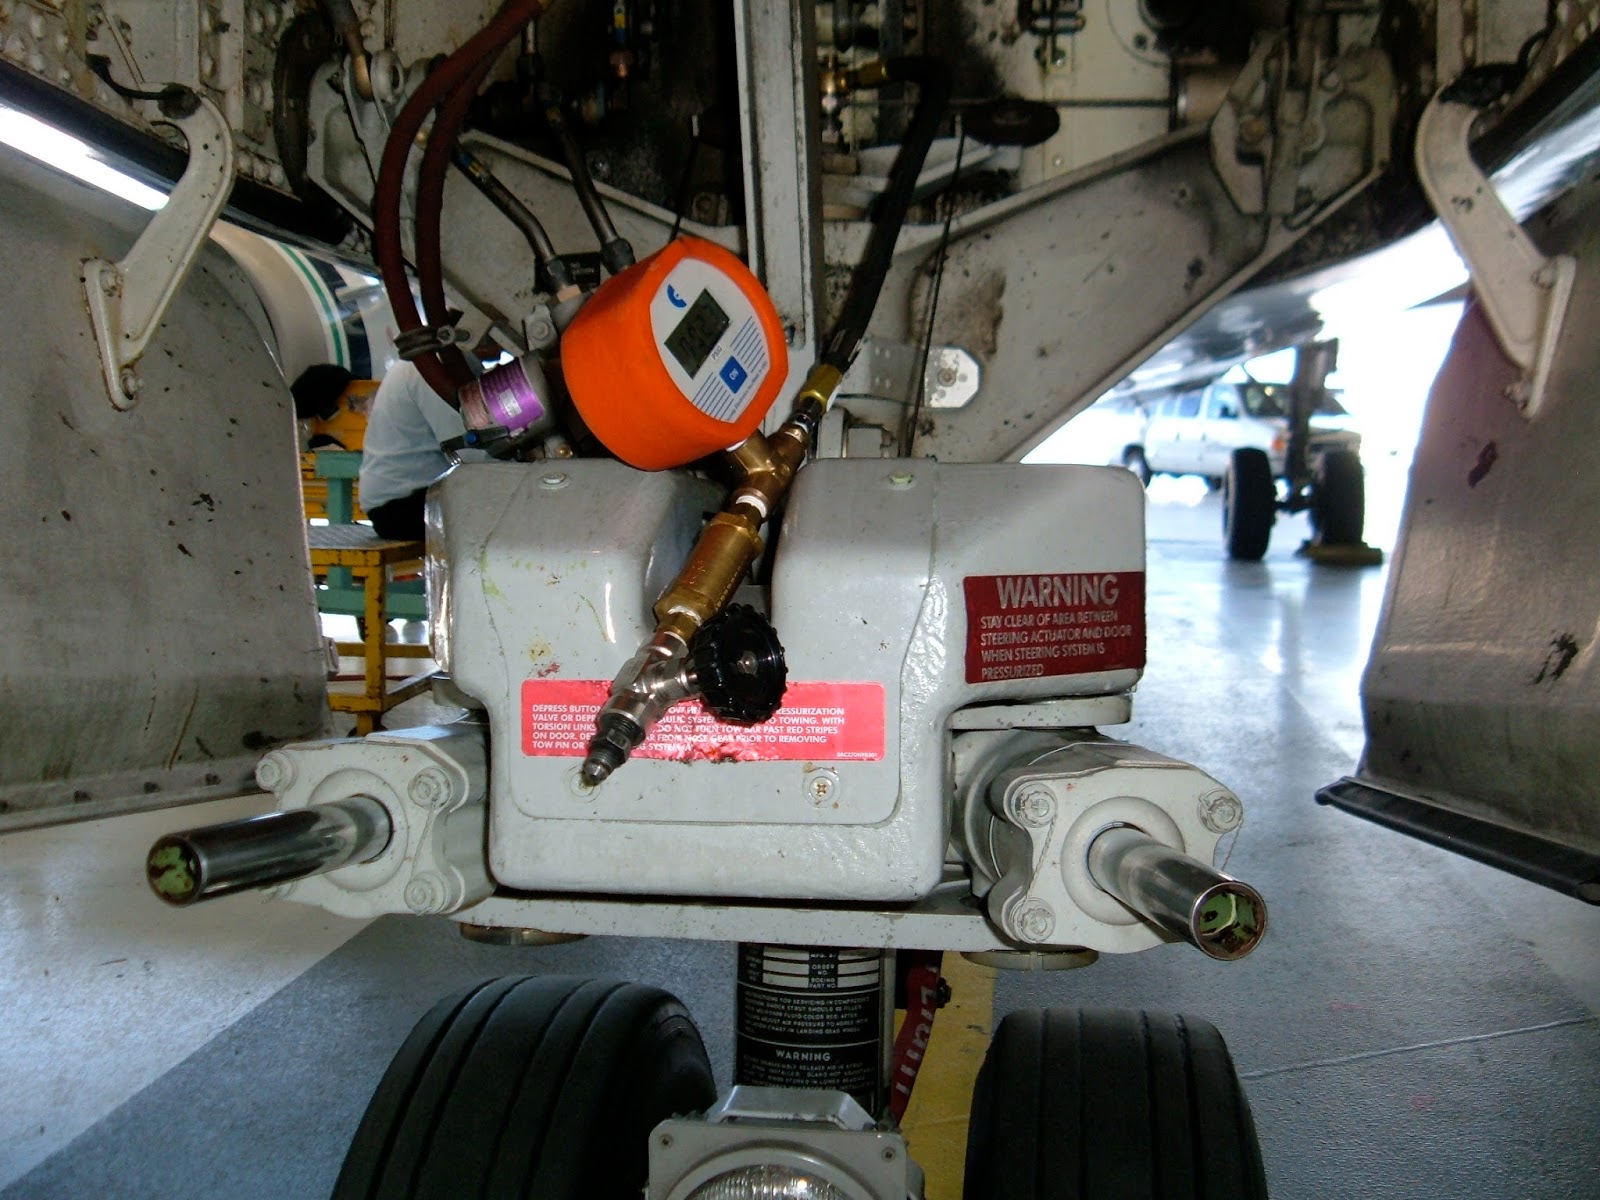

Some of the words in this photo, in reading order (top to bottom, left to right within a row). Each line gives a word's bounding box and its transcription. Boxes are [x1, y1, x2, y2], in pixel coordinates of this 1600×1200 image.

[729, 368, 739, 380] ON
[996, 574, 1119, 609] WARNING
[980, 615, 1002, 629] STAY
[1004, 614, 1035, 628] CLEAR
[1036, 613, 1050, 627] OF
[1052, 612, 1076, 626] AREA
[1077, 610, 1118, 624] BETWEEN
[980, 631, 1028, 646] STEERING
[1030, 628, 1081, 644] ACTUATOR
[1082, 626, 1102, 639] AND
[1104, 625, 1132, 638] DOOR
[981, 649, 1013, 662] WHEN
[1014, 645, 1061, 660] STEERING
[1062, 643, 1096, 657] SYSTEM
[1096, 642, 1105, 655] IS
[981, 663, 1044, 680] PRESSURIZED
[532, 704, 568, 713] DEPRESS
[668, 705, 685, 714] OW
[532, 713, 559, 722] VALVE
[560, 713, 573, 722] OR
[779, 717, 819, 725] TOWING.
[821, 717, 844, 725] WITH
[532, 722, 571, 731] TORSION
[573, 723, 597, 732] LINKS
[657, 725, 671, 733] DO
[673, 725, 693, 733] NOT
[695, 725, 719, 733] TURN
[721, 725, 742, 733] TOW
[786, 726, 804, 734] RED
[805, 726, 838, 734] STRIPES
[532, 732, 548, 740] ON
[550, 732, 577, 740] DOOR.
[710, 734, 735, 743] GEAR
[735, 735, 761, 743] PRIOR
[763, 735, 776, 743] TO
[778, 735, 827, 743] REMOVING
[532, 741, 553, 749] TOW
[555, 741, 570, 749] PIN
[571, 741, 584, 749] OR
[796, 1027, 824, 1035] LANDING
[776, 1050, 831, 1062] WARNING
